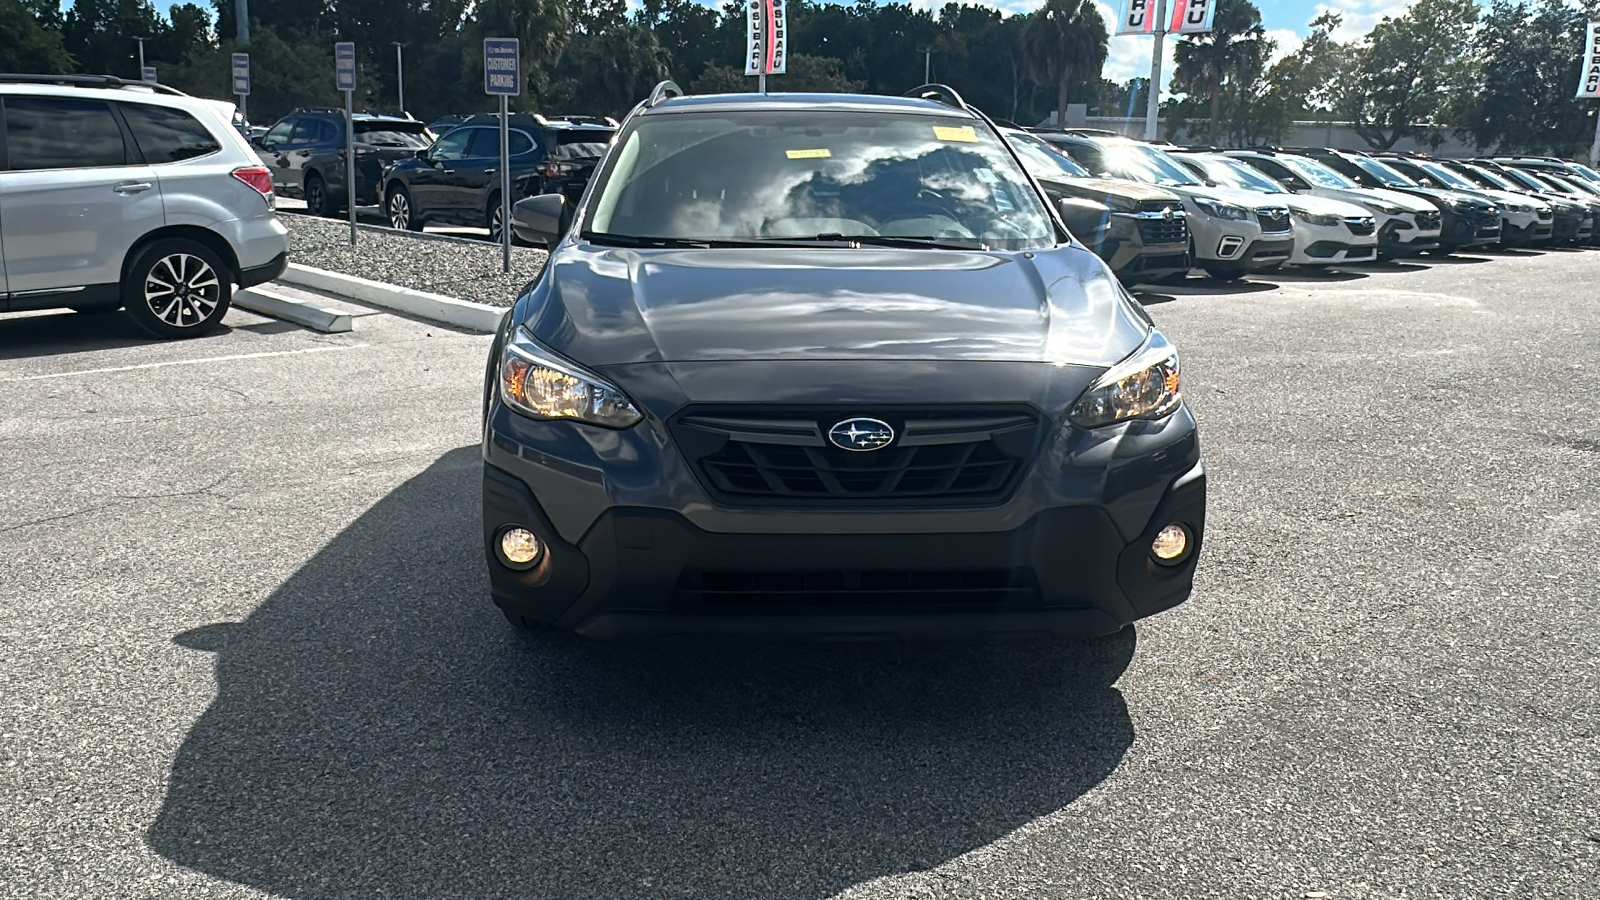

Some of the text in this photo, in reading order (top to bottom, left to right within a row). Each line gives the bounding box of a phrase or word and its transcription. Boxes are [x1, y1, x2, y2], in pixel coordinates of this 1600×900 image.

[773, 9, 784, 68] SUBARU
[487, 57, 517, 71] CUSTOMER
[490, 74, 514, 88] PARKING
